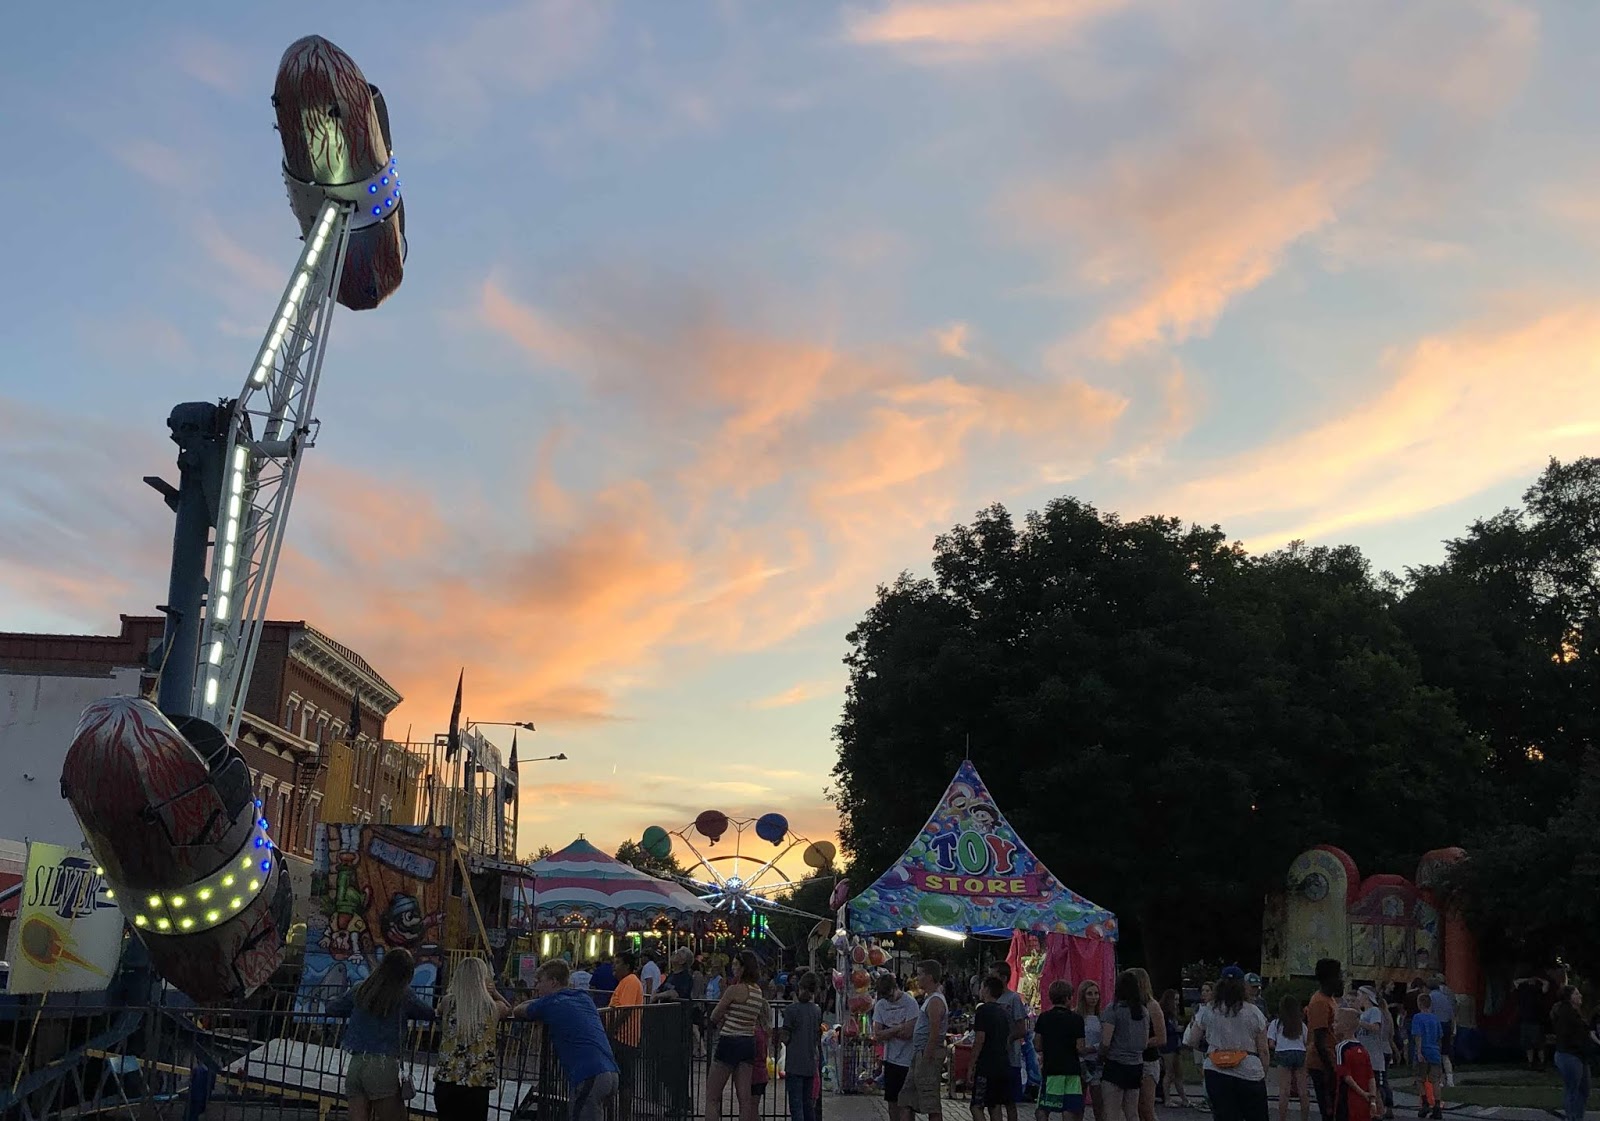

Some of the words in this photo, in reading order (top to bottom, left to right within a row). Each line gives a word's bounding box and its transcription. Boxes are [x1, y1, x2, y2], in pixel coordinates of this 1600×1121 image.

[930, 831, 1017, 875] TOY
[28, 864, 103, 914] SILVER
[925, 875, 1027, 894] STORE
